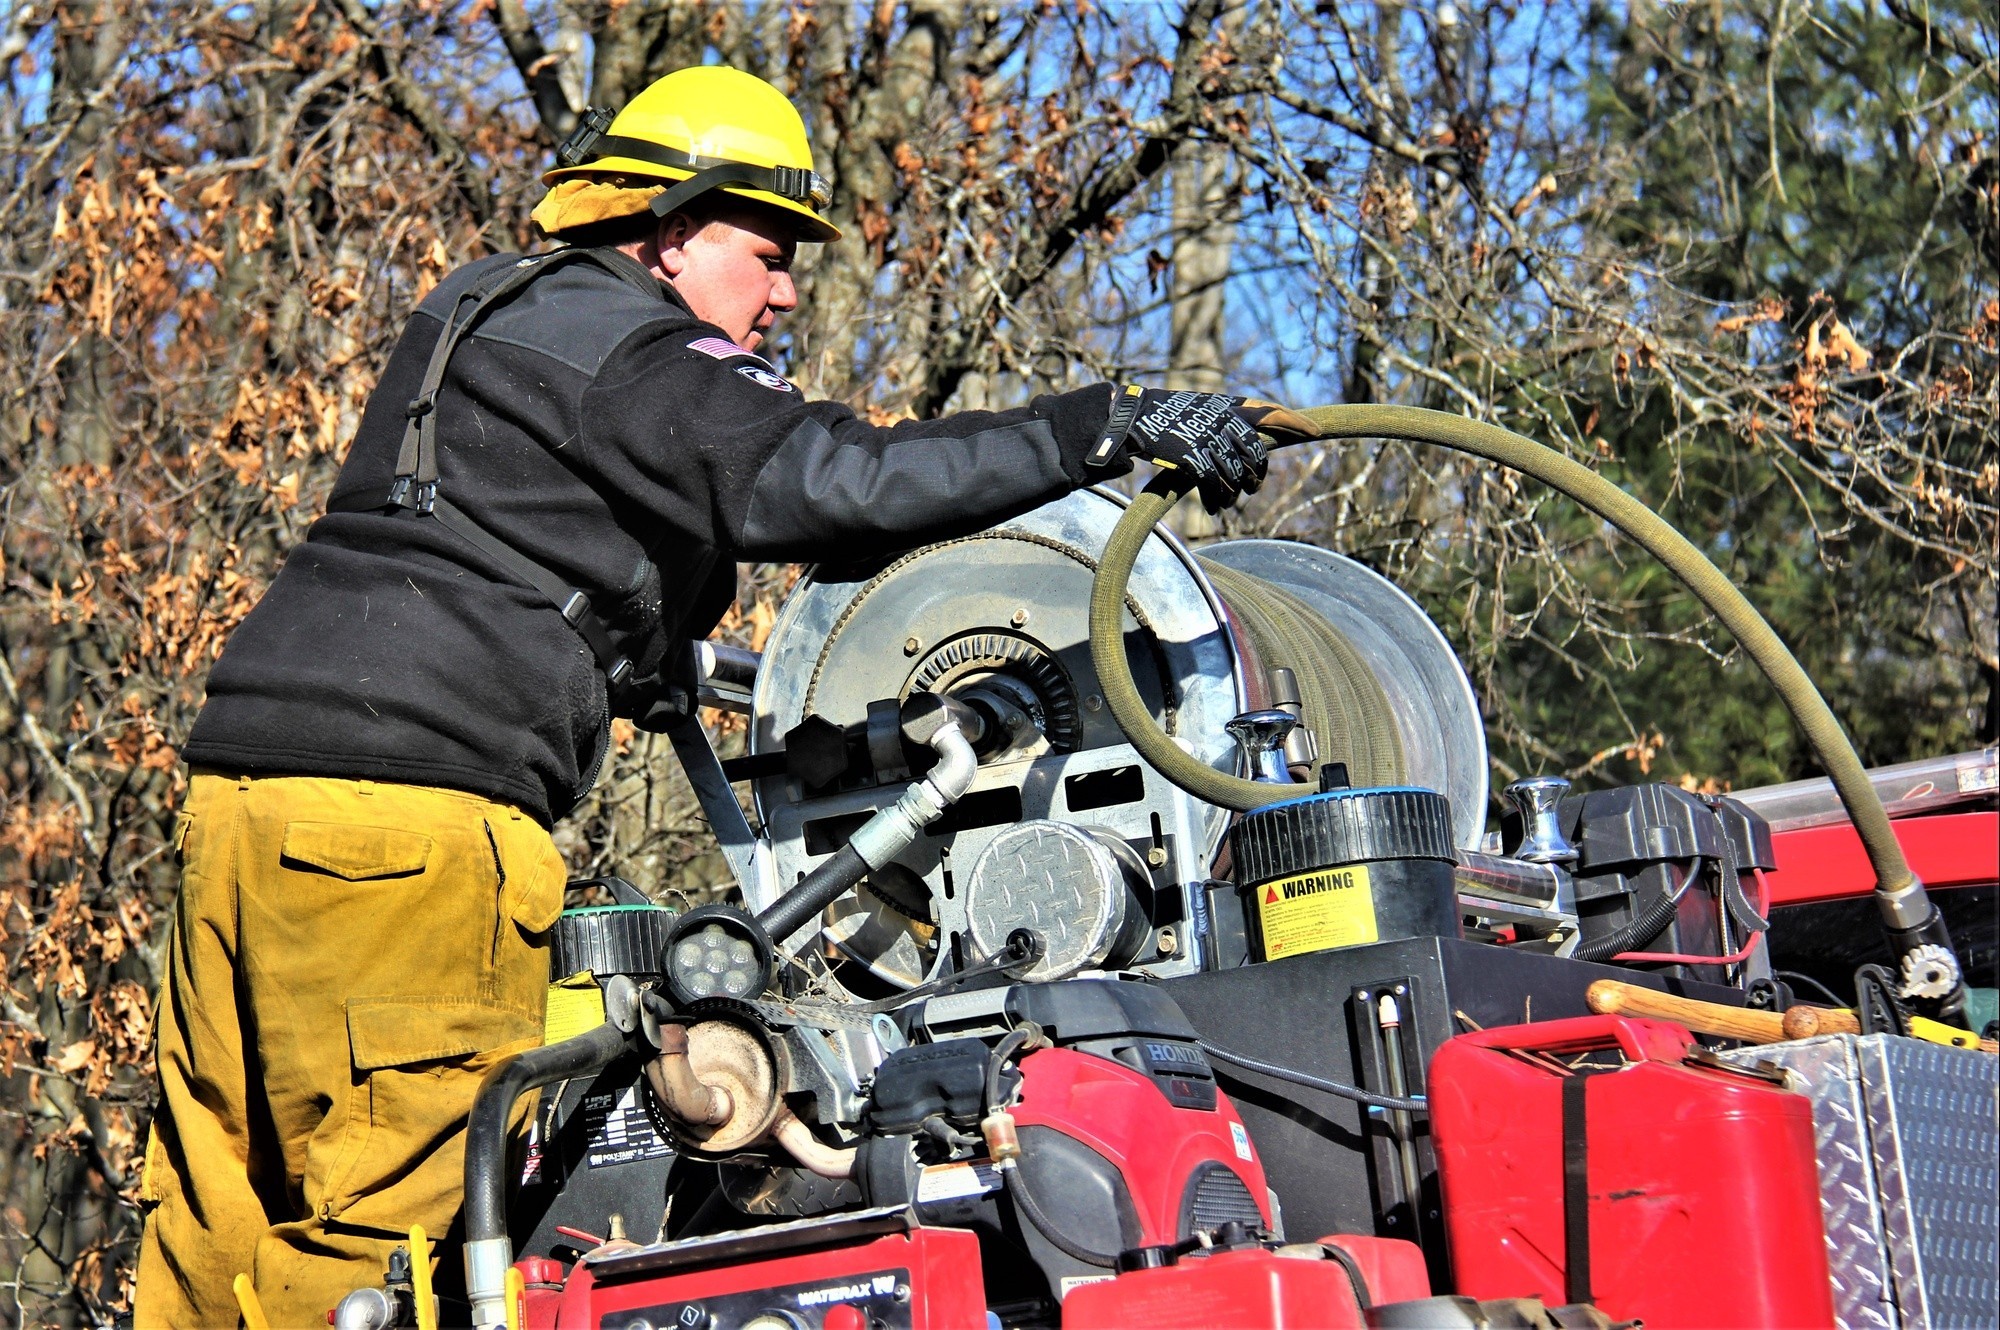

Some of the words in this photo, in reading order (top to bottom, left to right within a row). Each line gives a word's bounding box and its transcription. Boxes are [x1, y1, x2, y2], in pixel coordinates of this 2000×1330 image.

[1282, 871, 1354, 899] WARNING
[1145, 1043, 1210, 1067] HONDA
[798, 1283, 872, 1306] WATERAX
